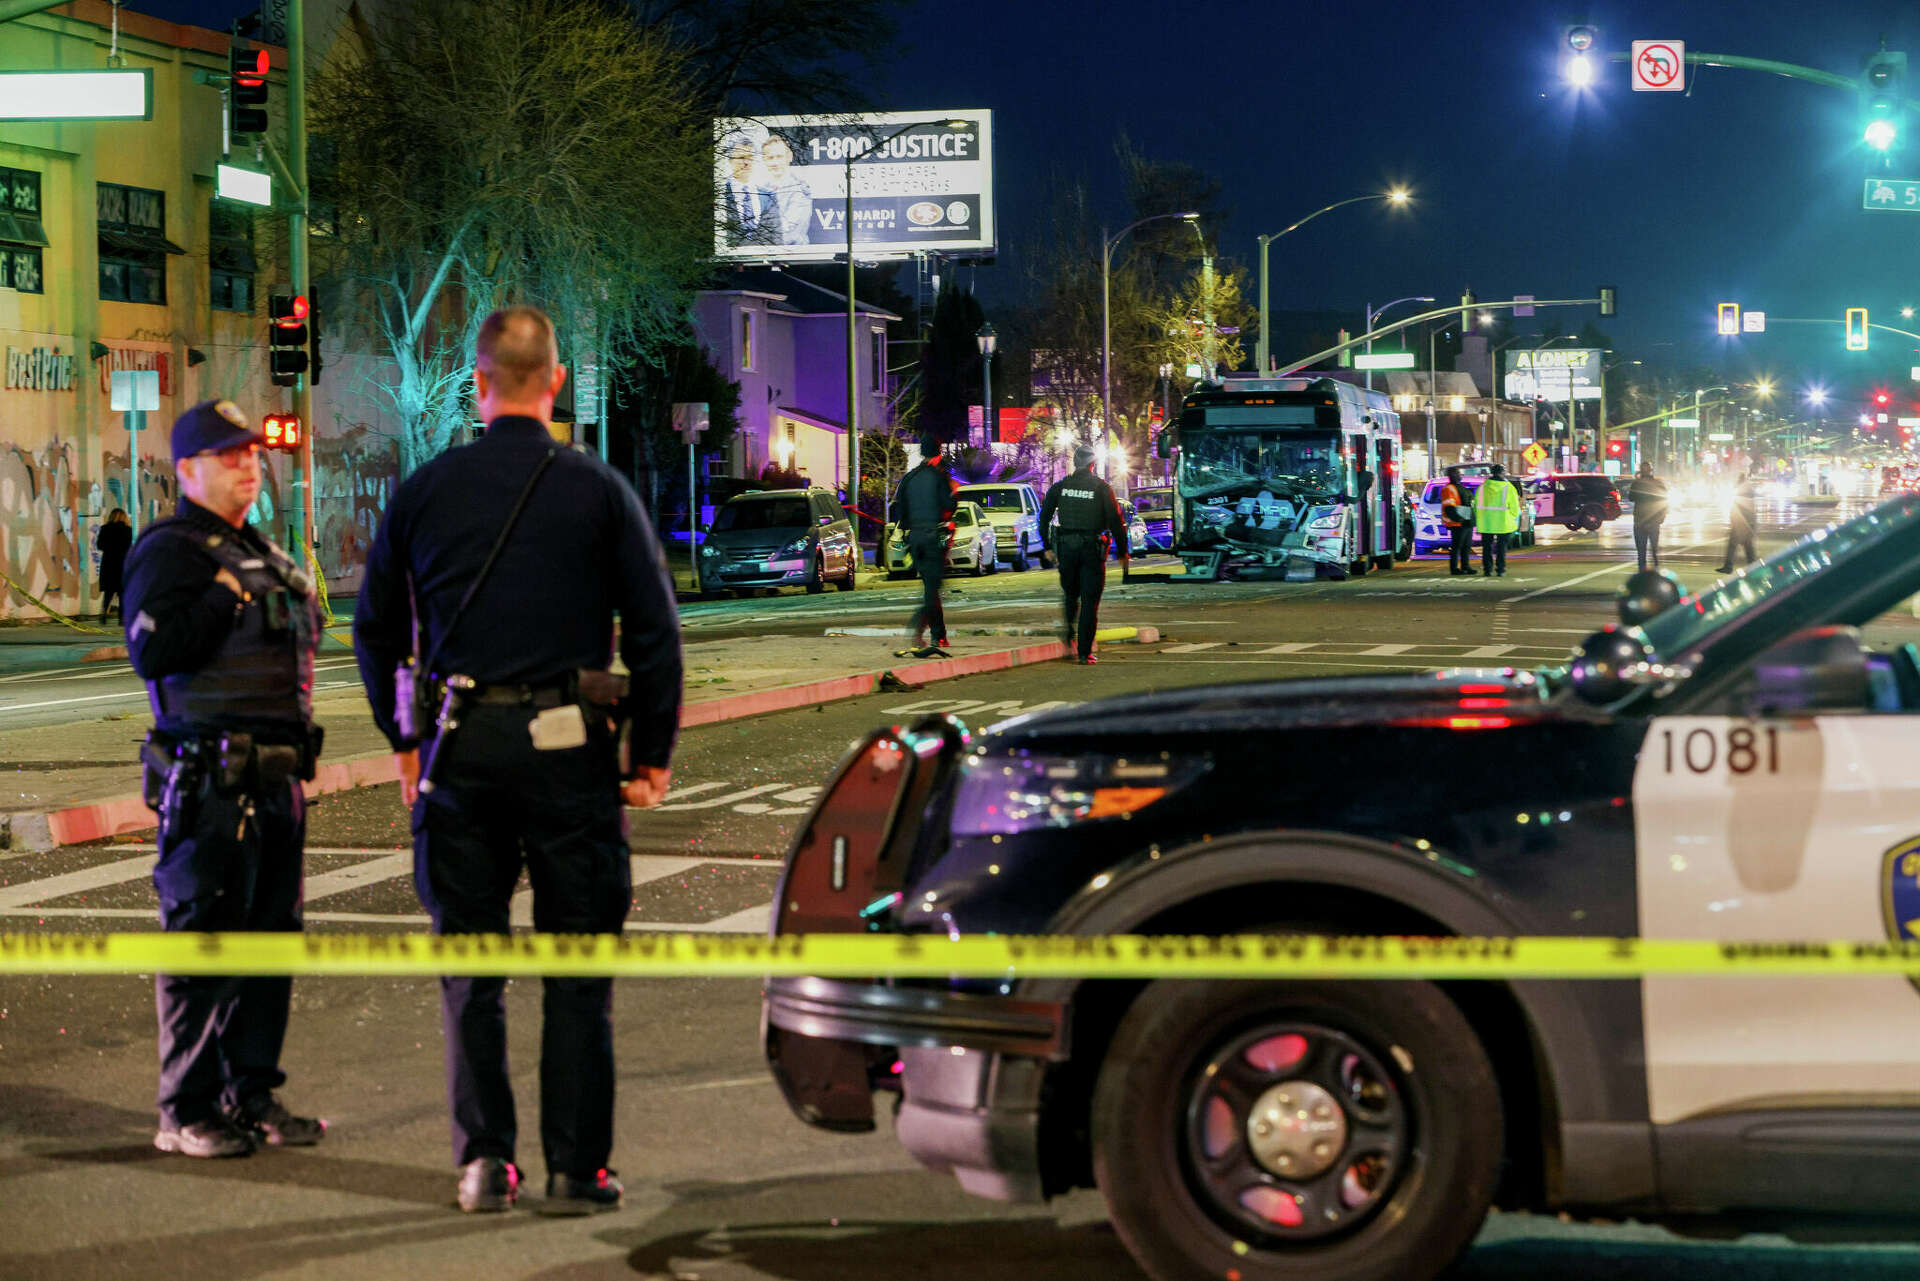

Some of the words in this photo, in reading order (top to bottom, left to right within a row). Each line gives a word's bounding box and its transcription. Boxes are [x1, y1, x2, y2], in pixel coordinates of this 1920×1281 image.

[808, 135, 871, 161] 1-800
[836, 208, 896, 222] VNARDI
[1061, 488, 1095, 499] POLICE
[1662, 727, 1780, 774] 1081
